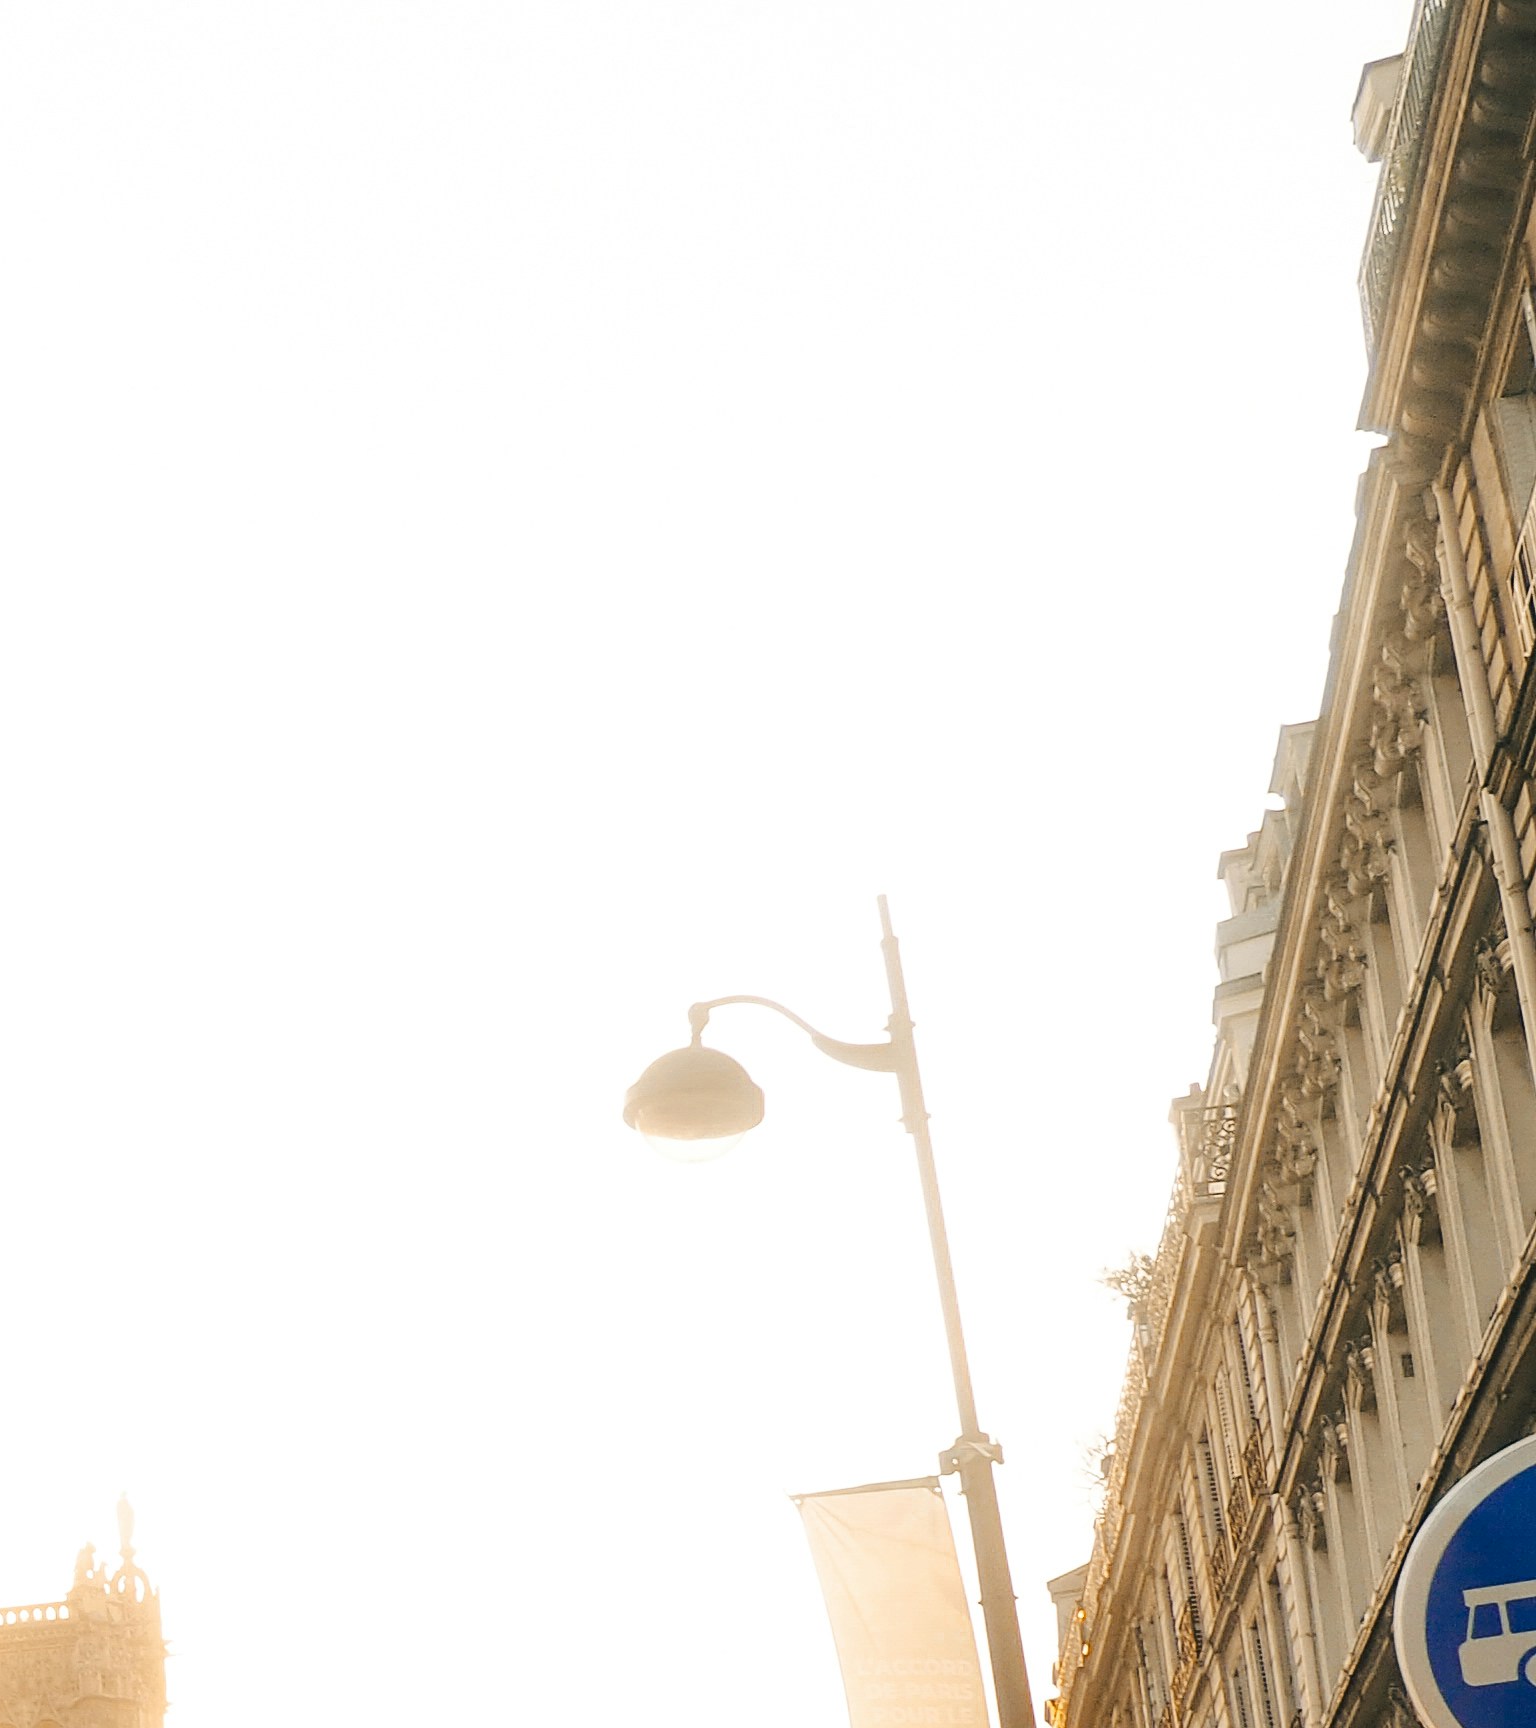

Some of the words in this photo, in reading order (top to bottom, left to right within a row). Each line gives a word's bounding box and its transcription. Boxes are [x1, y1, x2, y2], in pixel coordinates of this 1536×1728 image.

[857, 1657, 974, 1676] L'ACCORD
[864, 1683, 898, 1700] DE
[907, 1683, 975, 1701] PARIS
[874, 1706, 938, 1725] POUR
[947, 1706, 976, 1725] LE
